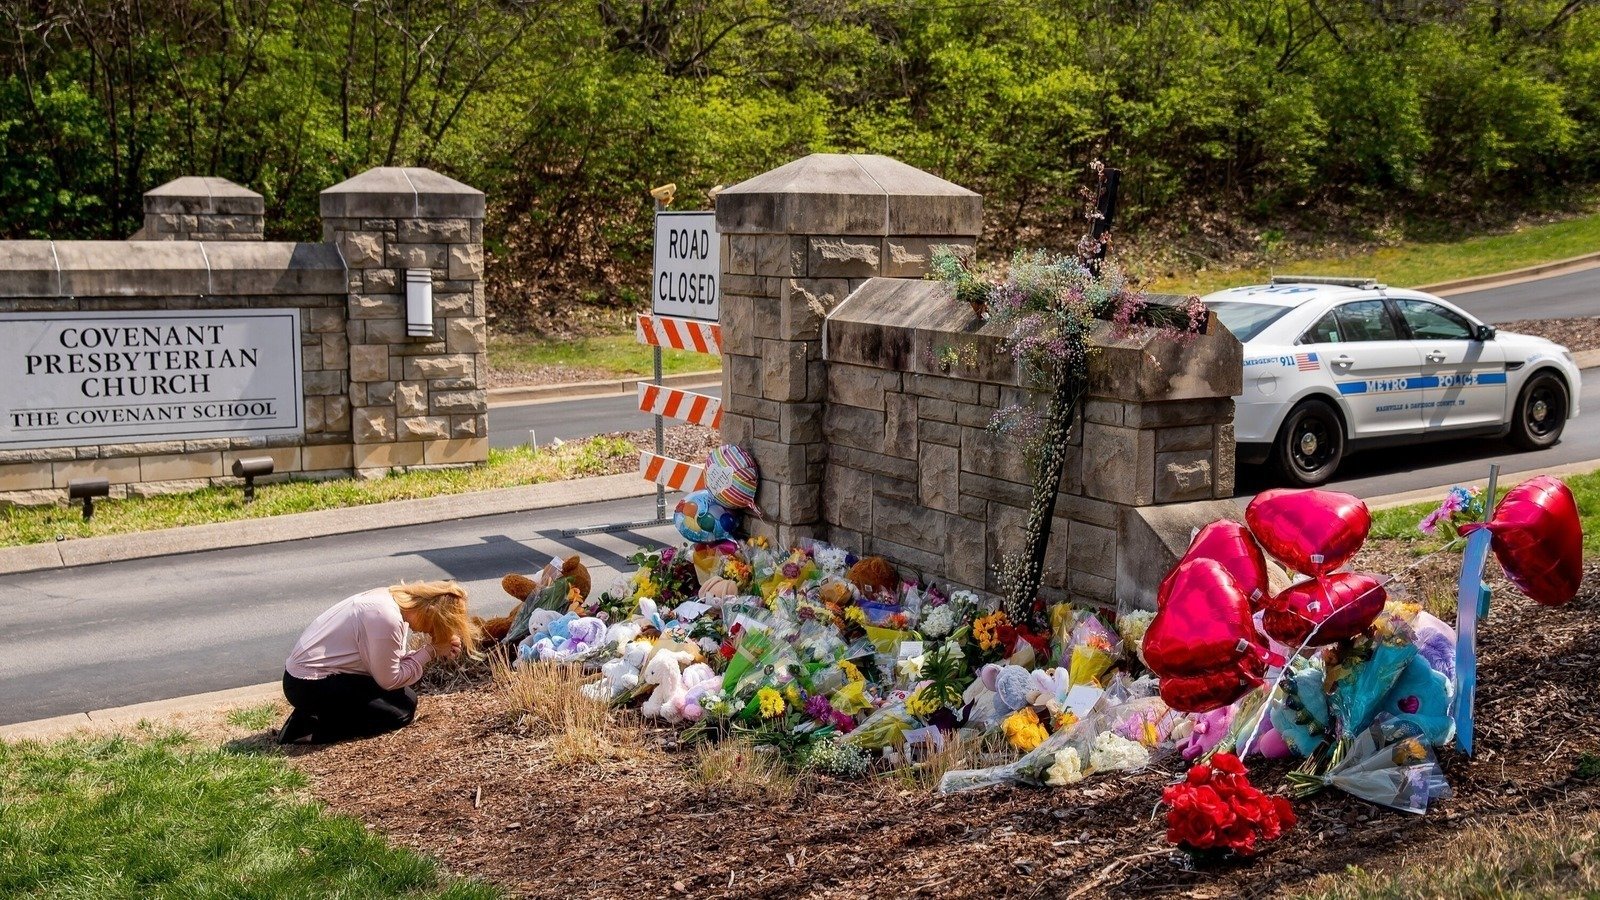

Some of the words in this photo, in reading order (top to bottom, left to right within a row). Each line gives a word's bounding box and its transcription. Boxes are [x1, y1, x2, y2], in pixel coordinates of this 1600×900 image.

[669, 228, 709, 260] ROAD
[659, 271, 715, 305] CLOSED
[60, 325, 224, 349] COVENANT
[25, 348, 258, 376] PRESBYTERIAN
[1280, 356, 1296, 367] 911
[81, 373, 211, 398] CHURCH
[1366, 378, 1408, 392] METRO
[1438, 375, 1478, 387] POLICE
[10, 411, 60, 428] THE
[66, 406, 187, 425] COVENANT
[193, 402, 277, 418] SCHOOL
[1375, 404, 1403, 412] NASHVILLE
[1410, 402, 1435, 410] DAVIDSON
